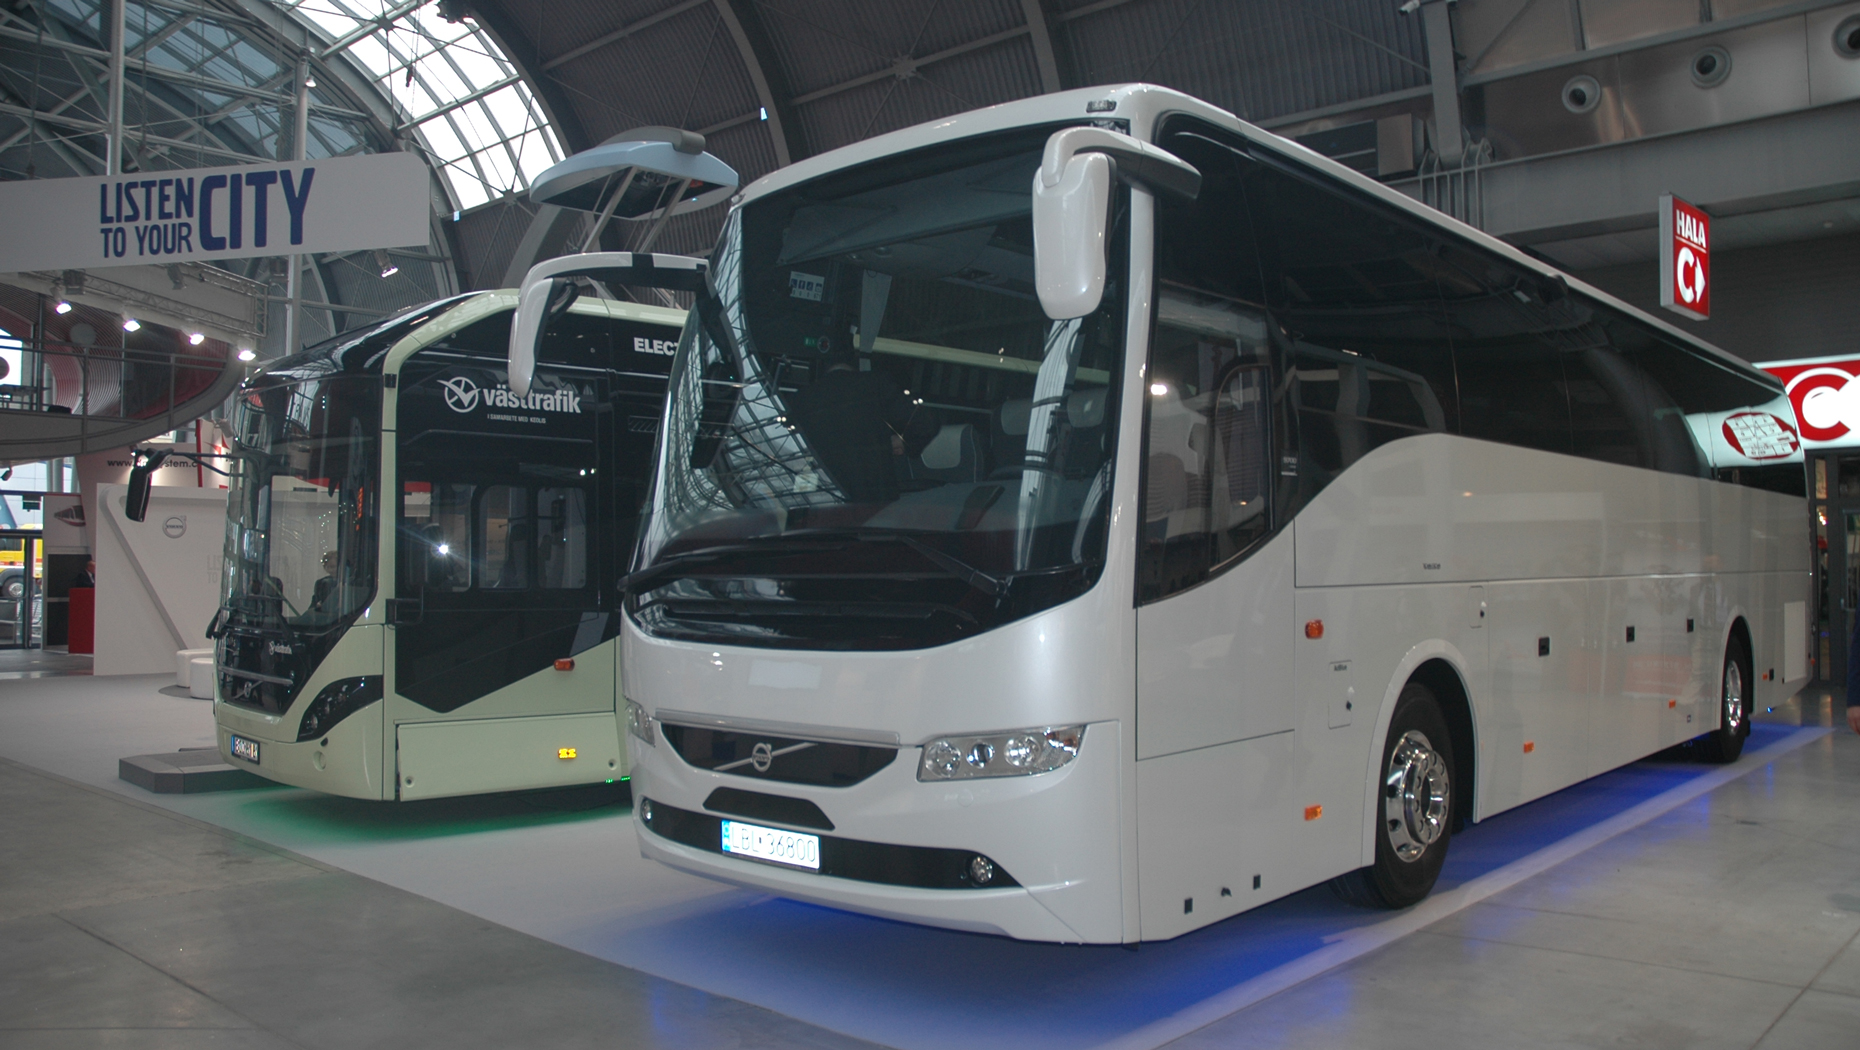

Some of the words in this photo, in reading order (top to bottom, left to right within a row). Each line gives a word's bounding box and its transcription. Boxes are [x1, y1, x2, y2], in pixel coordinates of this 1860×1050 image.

[100, 177, 194, 224] LISTEN
[200, 167, 315, 251] CITY
[100, 227, 126, 258] TO
[134, 222, 193, 256] YOUR
[1676, 209, 1706, 248] HALA
[1677, 247, 1695, 303] C
[1788, 374, 1851, 441] C
[732, 826, 759, 852] LBL
[766, 832, 816, 862] 36800
